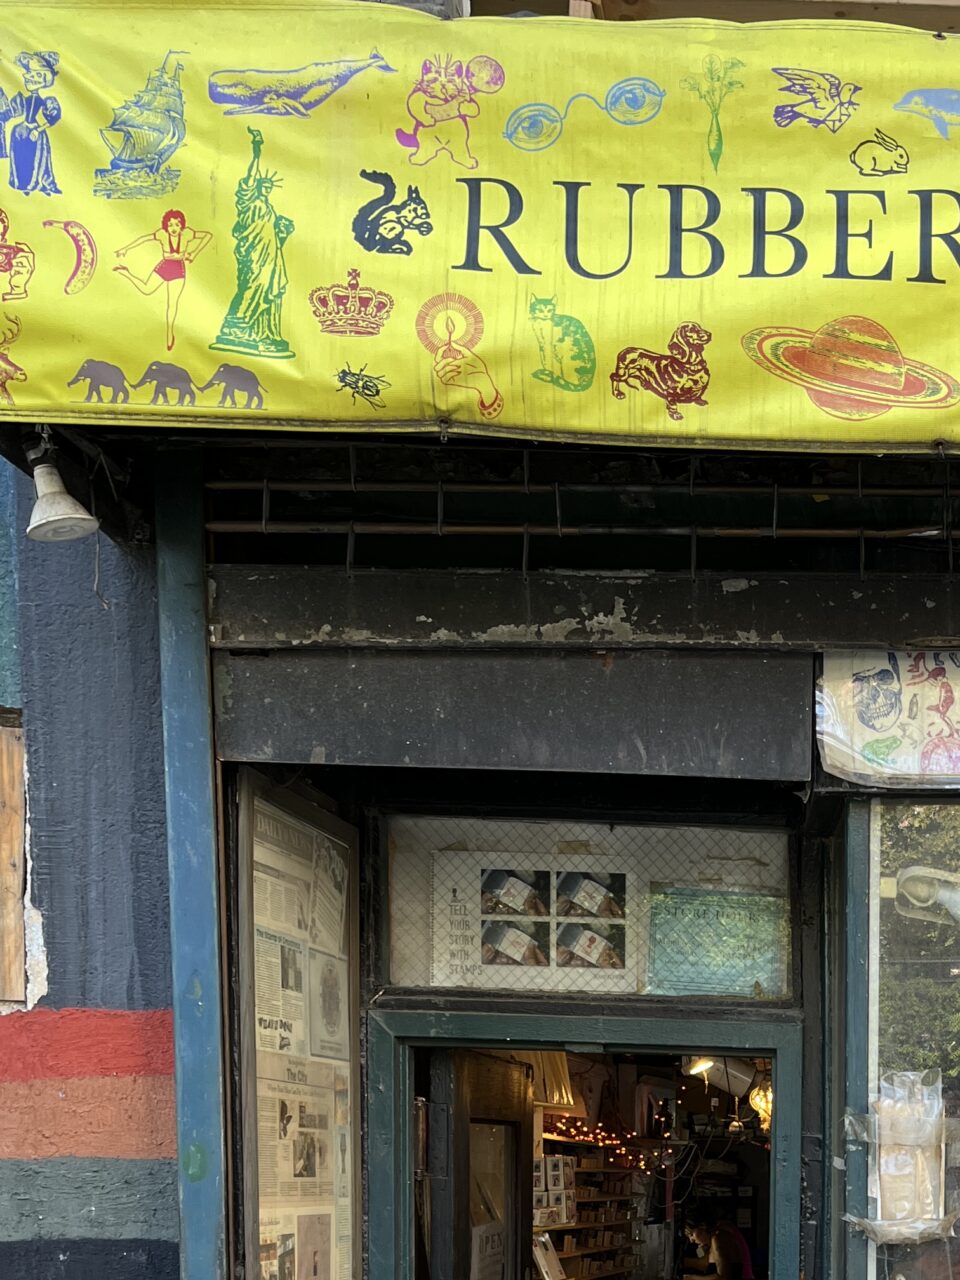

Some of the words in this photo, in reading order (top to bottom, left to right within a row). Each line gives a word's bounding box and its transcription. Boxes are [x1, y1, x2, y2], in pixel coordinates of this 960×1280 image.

[256, 813, 282, 841] DAILY
[448, 904, 469, 917] TELL
[448, 919, 471, 931] YOUR
[448, 934, 475, 946] STORY
[449, 949, 470, 961] WITH
[448, 963, 483, 976] STAMPS
[479, 1232, 503, 1257] OPEN
